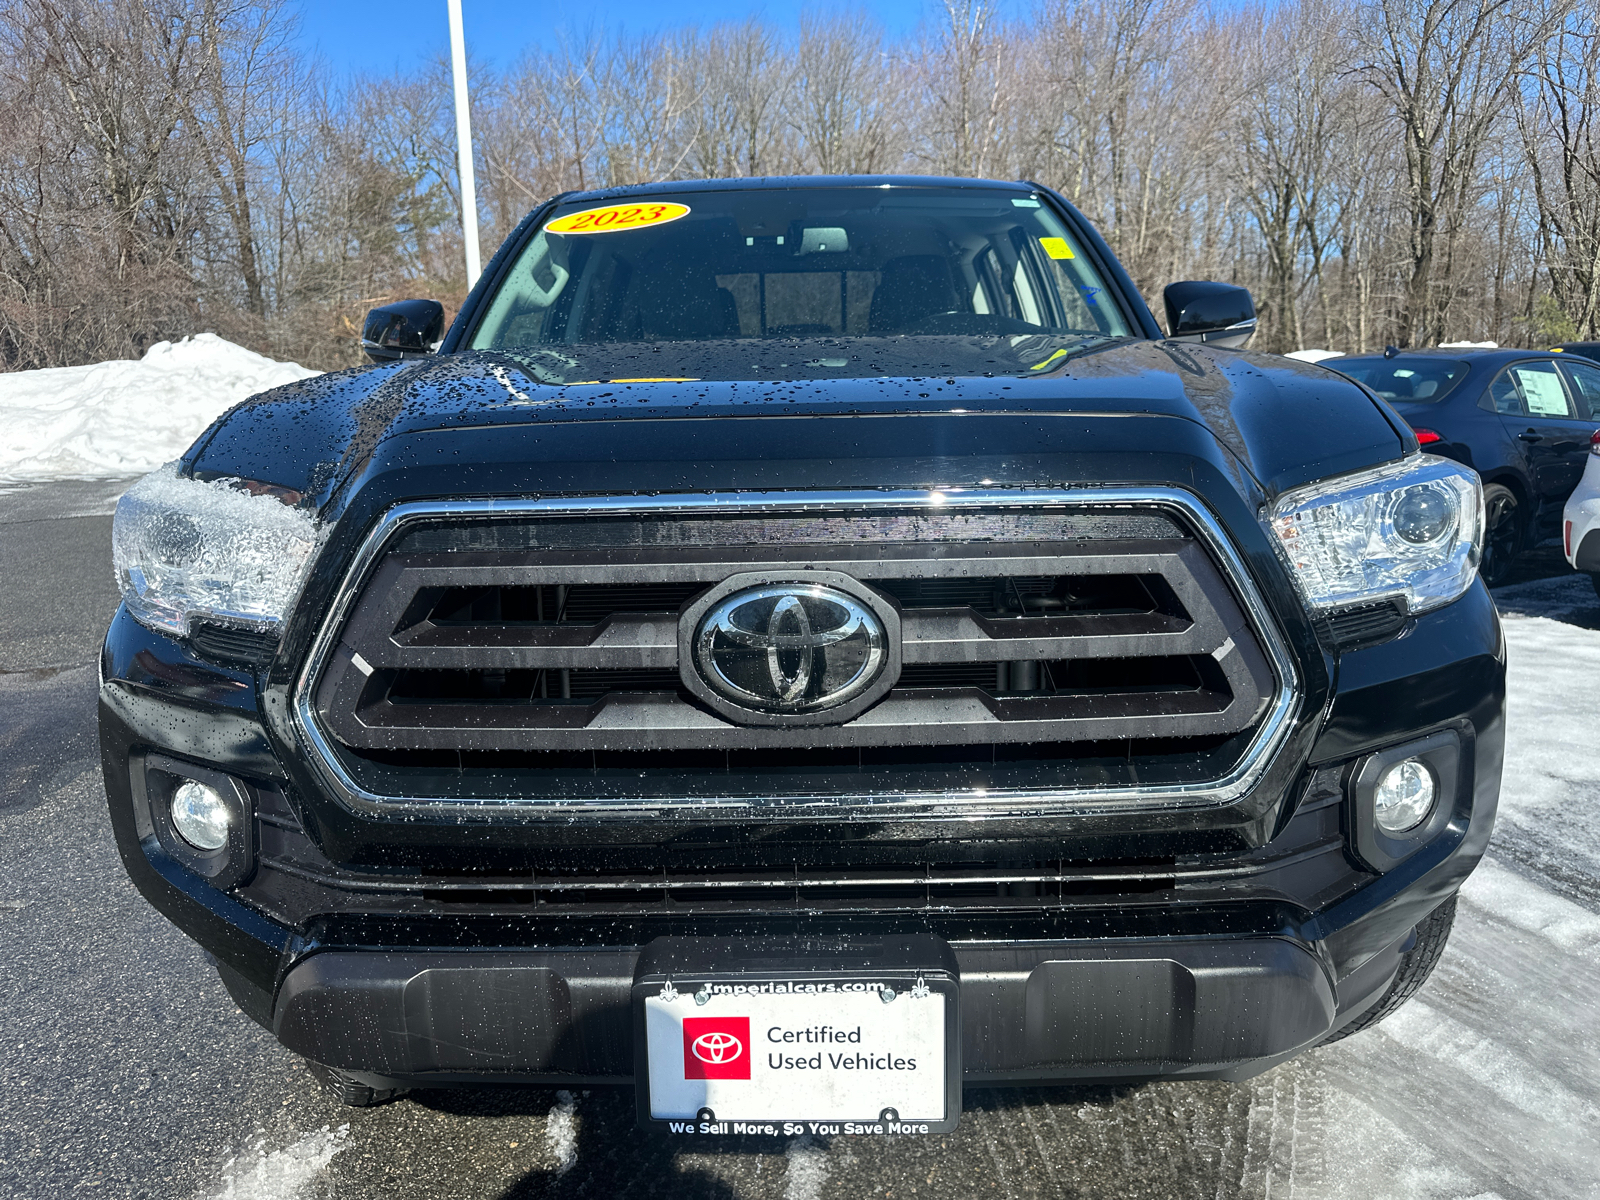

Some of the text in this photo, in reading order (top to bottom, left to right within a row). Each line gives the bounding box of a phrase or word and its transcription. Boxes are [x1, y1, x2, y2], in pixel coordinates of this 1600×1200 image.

[568, 206, 667, 231] 2023
[704, 982, 885, 996] Imperialcars.com
[767, 1026, 861, 1044] Certified
[768, 1052, 917, 1071] Used Vehicles
[669, 1122, 929, 1137] We Sell More, So You Save More
